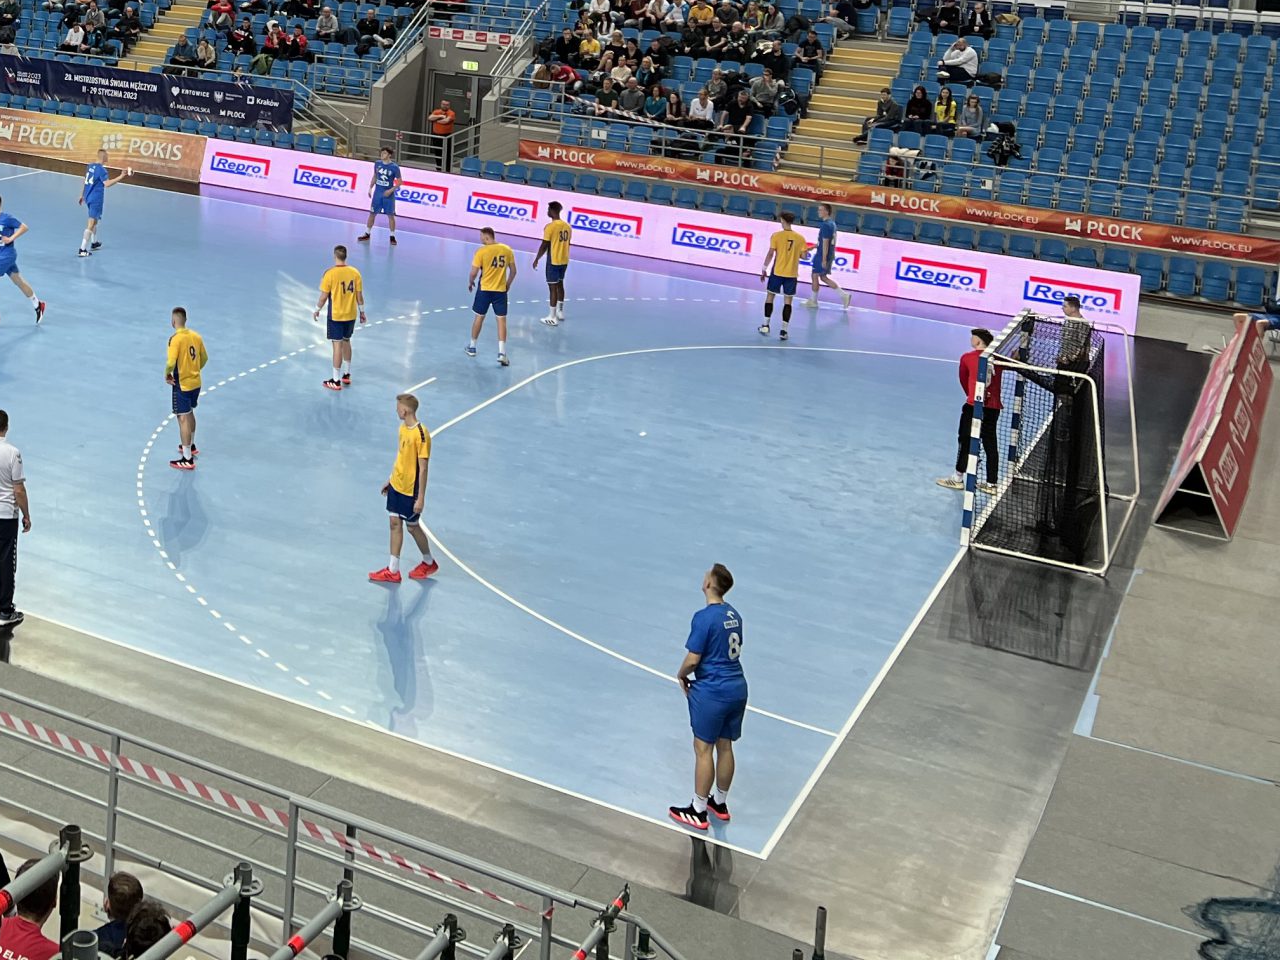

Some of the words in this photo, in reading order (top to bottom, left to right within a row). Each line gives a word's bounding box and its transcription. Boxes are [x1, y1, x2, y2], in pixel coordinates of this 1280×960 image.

[64, 73, 73, 81] 28.
[73, 75, 109, 87] MISTRZOSTWA
[129, 81, 158, 93] MĘŻCZYZN
[90, 87, 97, 95] 29
[98, 88, 122, 98] STYCZNIA
[123, 91, 138, 100] 2023
[181, 88, 210, 98] KATOWICE
[256, 97, 280, 108] Kraków
[176, 103, 211, 114] MAŁOPOLSKA
[227, 110, 246, 120] PŁOCK
[18, 124, 77, 150] PŁOCK
[128, 138, 183, 161] POKIS
[215, 157, 261, 174] Repro
[553, 149, 595, 166] PŁOCK
[615, 159, 676, 175] WWW.PLOCK.EU
[298, 170, 347, 189] Repro
[713, 171, 759, 188] PŁOCK
[782, 182, 848, 198] WWW.PLOCK.EU
[473, 197, 527, 218] Repro
[890, 193, 941, 213] PŁOCK
[965, 207, 1039, 224] WWW.PLOCK.EU
[574, 213, 632, 234] Repro
[559, 230, 568, 242] 30
[678, 229, 741, 249] Repro
[787, 239, 793, 250] 7
[1086, 220, 1143, 241] PŁOCK
[1171, 235, 1253, 254] WWW.PLOCK.EU
[491, 254, 505, 268] 45
[903, 261, 974, 286] Repro
[340, 280, 354, 295] 14
[189, 345, 196, 360] 9
[729, 632, 741, 660] 8
